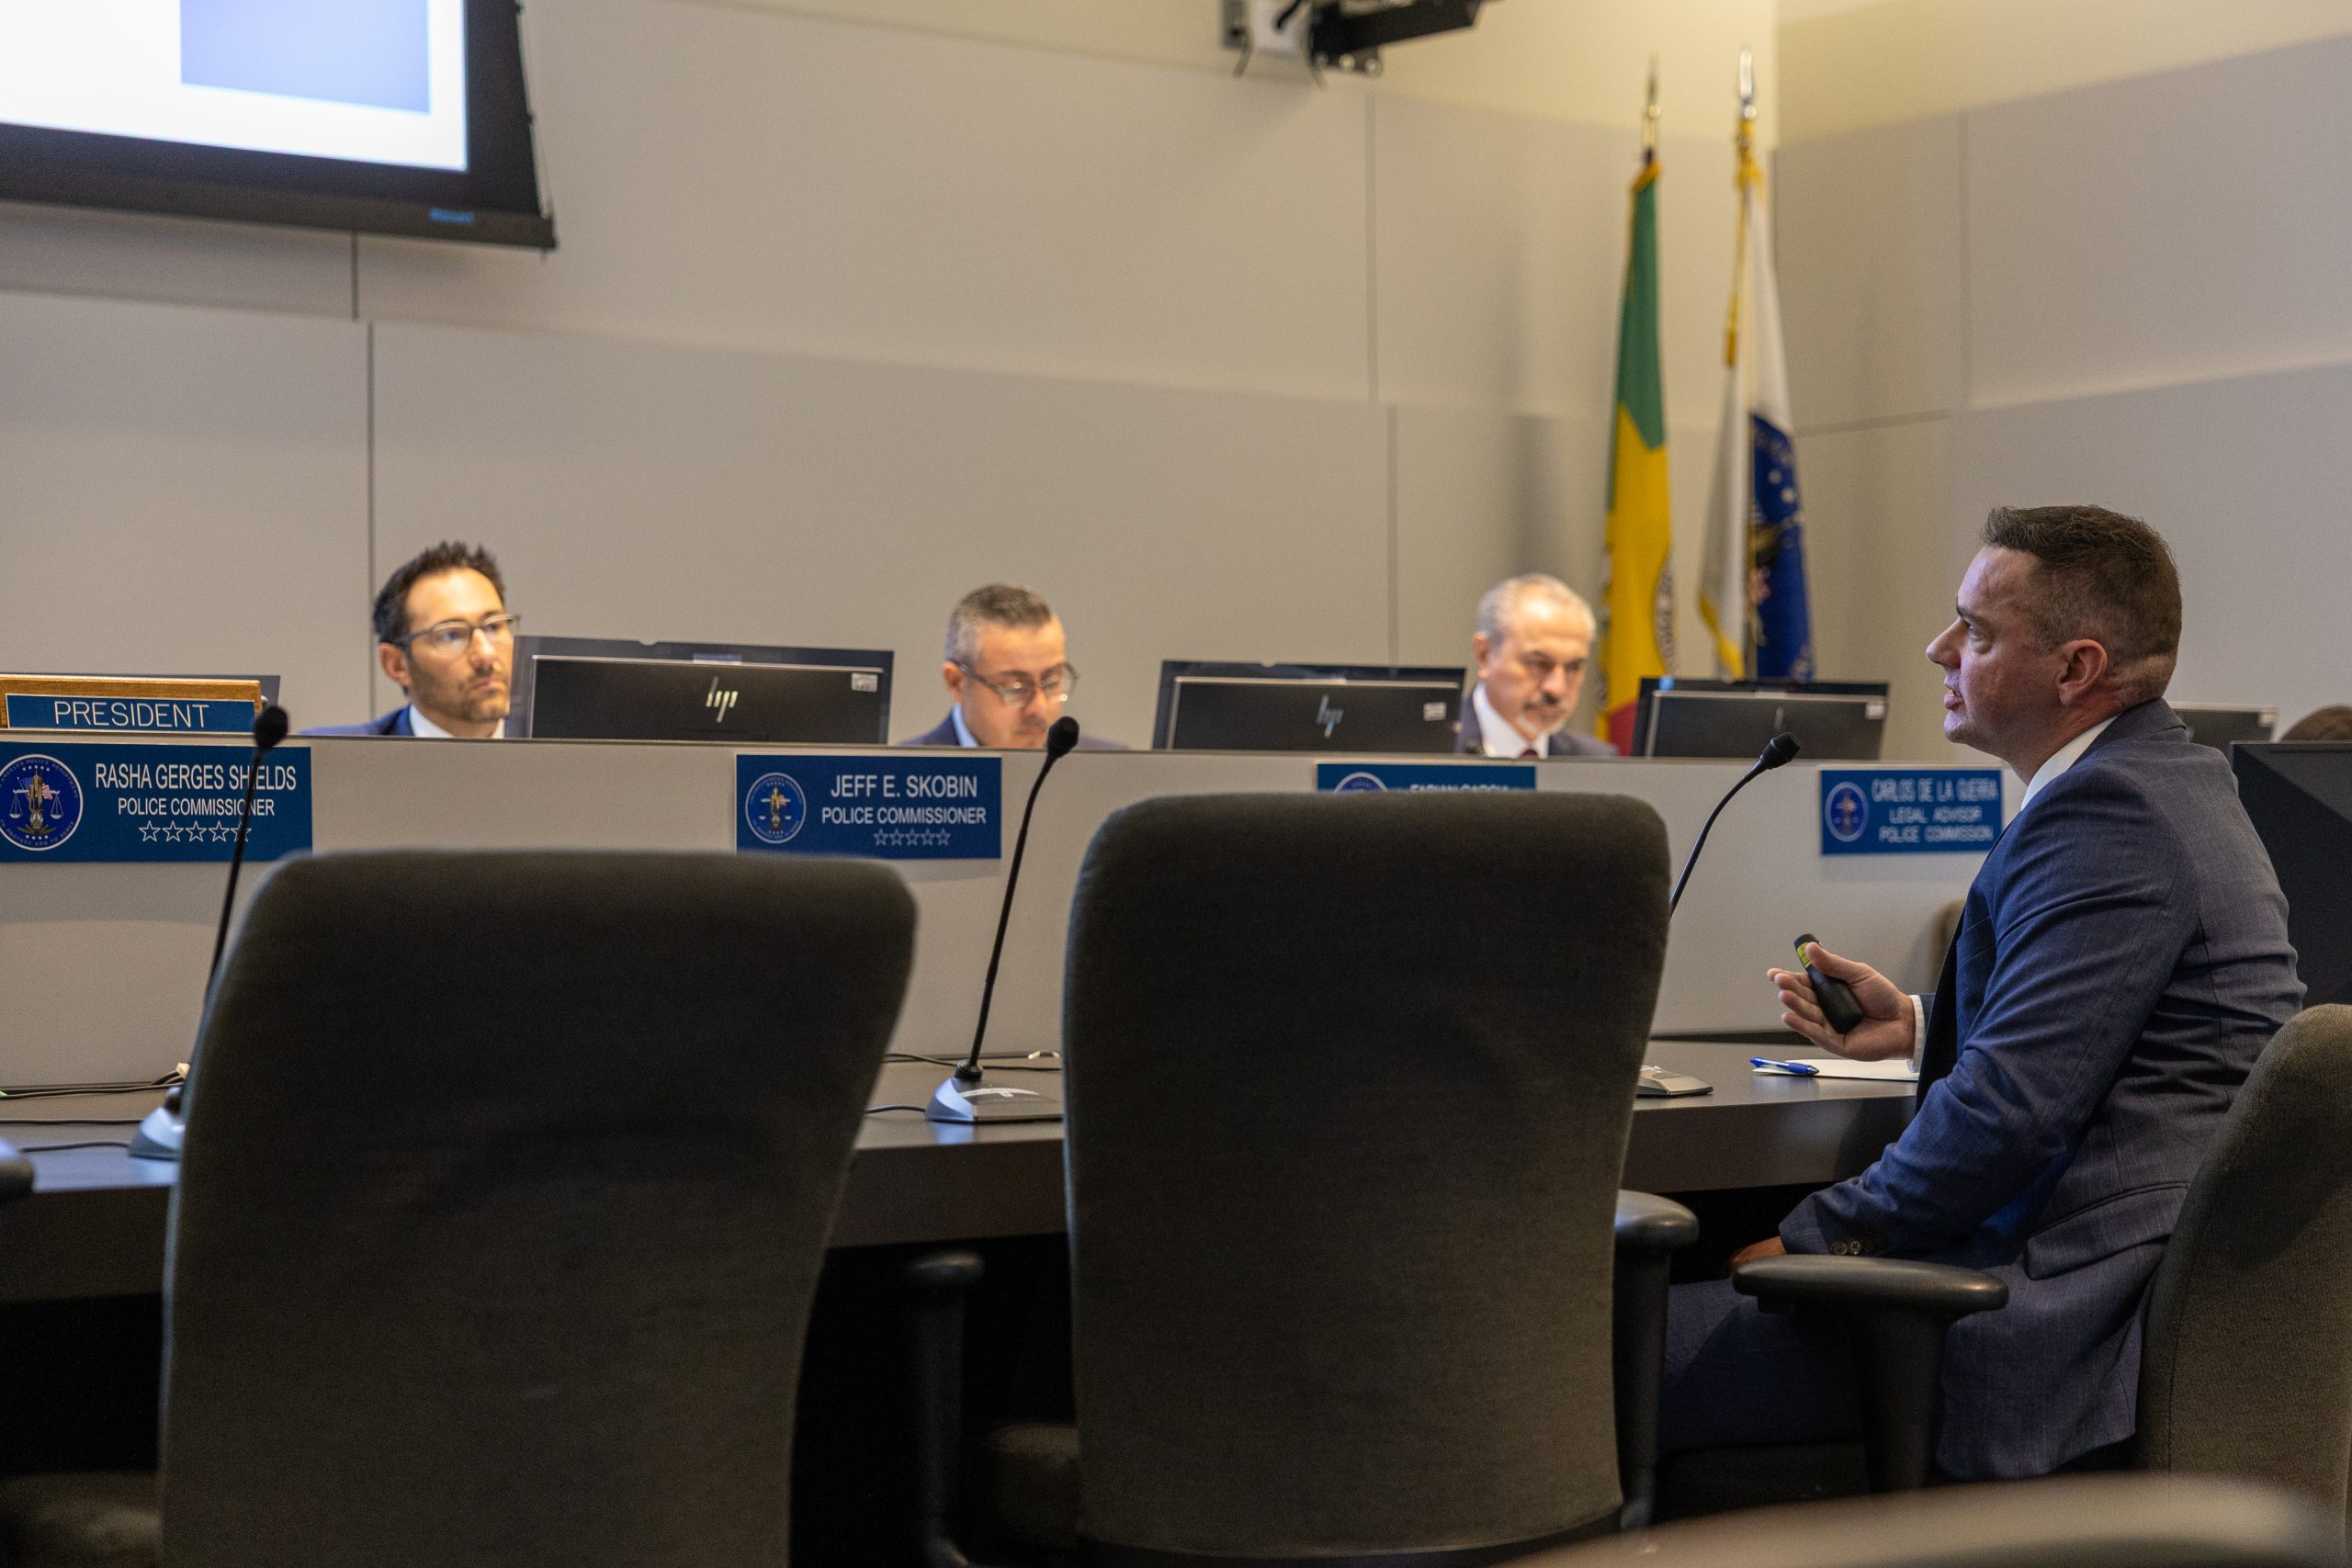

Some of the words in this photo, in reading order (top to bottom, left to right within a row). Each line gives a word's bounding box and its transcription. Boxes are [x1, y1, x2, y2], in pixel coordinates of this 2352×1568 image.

[53, 700, 209, 728] PRESIDENT
[96, 762, 152, 789] RASHA
[155, 763, 224, 790] GERGES
[229, 764, 297, 791] SHELDS
[831, 774, 877, 798] JEFF
[883, 775, 900, 797] E.
[906, 775, 978, 798] SKOBIN
[118, 796, 167, 816] POLICE
[171, 797, 275, 817] COMMISSIONER
[822, 807, 874, 825] POLICE
[876, 807, 987, 825] COMMISSIONER
